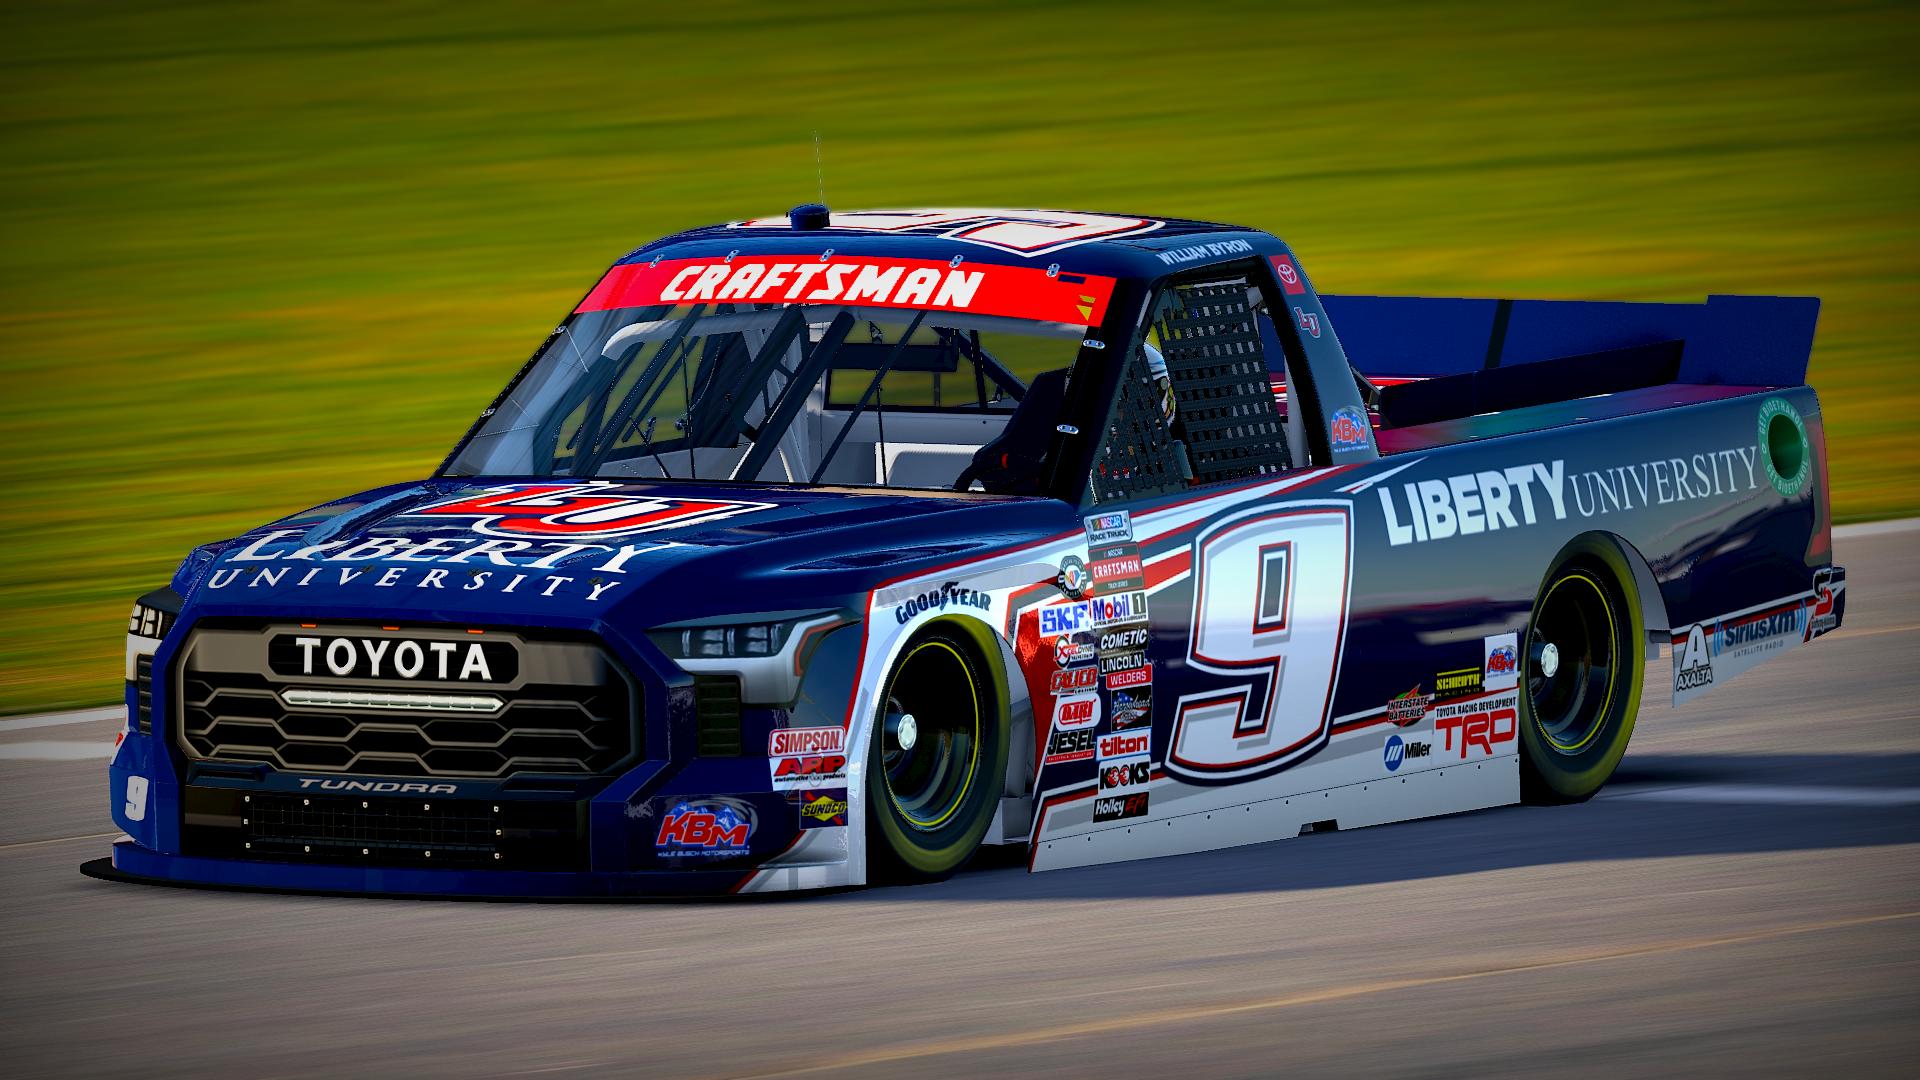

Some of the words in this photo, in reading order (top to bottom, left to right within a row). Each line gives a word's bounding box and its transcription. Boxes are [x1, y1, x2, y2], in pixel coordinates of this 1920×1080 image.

[1156, 246, 1211, 266] WILLIAM
[1206, 239, 1253, 256] BYRON
[660, 263, 985, 308] CRAFTSMAN
[1331, 416, 1366, 444] KBM
[1377, 460, 1564, 547] LIBERTY
[1568, 446, 1758, 518] UNIVERSITY
[1100, 514, 1123, 529] NASCAR
[1090, 530, 1106, 542] RACE
[1107, 529, 1128, 539] TRUCK
[225, 529, 678, 574] LIBERTY
[1093, 560, 1139, 578] CRAFTSMAN
[207, 567, 621, 601] UNIVERSITY
[895, 581, 992, 625] GOODYEAR
[1092, 594, 1130, 621] Mobil
[1135, 595, 1142, 614] 1
[1042, 604, 1088, 633] SKF
[1100, 628, 1148, 650] COMETIC
[1164, 499, 1355, 783] 9
[1734, 645, 1763, 658] SATELLITE
[1765, 640, 1784, 652] RADIO
[296, 637, 493, 681] TOYOTA
[1101, 654, 1143, 673] LINCOLN
[1486, 653, 1515, 674] KBM
[1110, 670, 1147, 686] WELDERS
[1436, 672, 1481, 691] SCHROTH
[1676, 667, 1713, 691] AXALTA
[1388, 697, 1429, 710] INTERSTATE
[1389, 708, 1425, 721] BATTERIES
[1436, 705, 1456, 718] TOYOTA
[1458, 702, 1477, 714] RACING
[1479, 697, 1516, 712] DEVELOPMENT
[774, 731, 843, 754] SIMPSON
[1047, 728, 1096, 755] JESEL
[1436, 709, 1516, 758] TRD
[1100, 736, 1147, 757] tilton
[1405, 741, 1431, 758] Miller
[773, 755, 847, 777] ARP
[1100, 762, 1150, 790] KOOKS
[299, 778, 457, 795] TUNDRA
[125, 775, 149, 821] 9
[803, 801, 847, 816] SUNOCO
[1095, 798, 1125, 816] Holley
[656, 811, 750, 847] KBM
